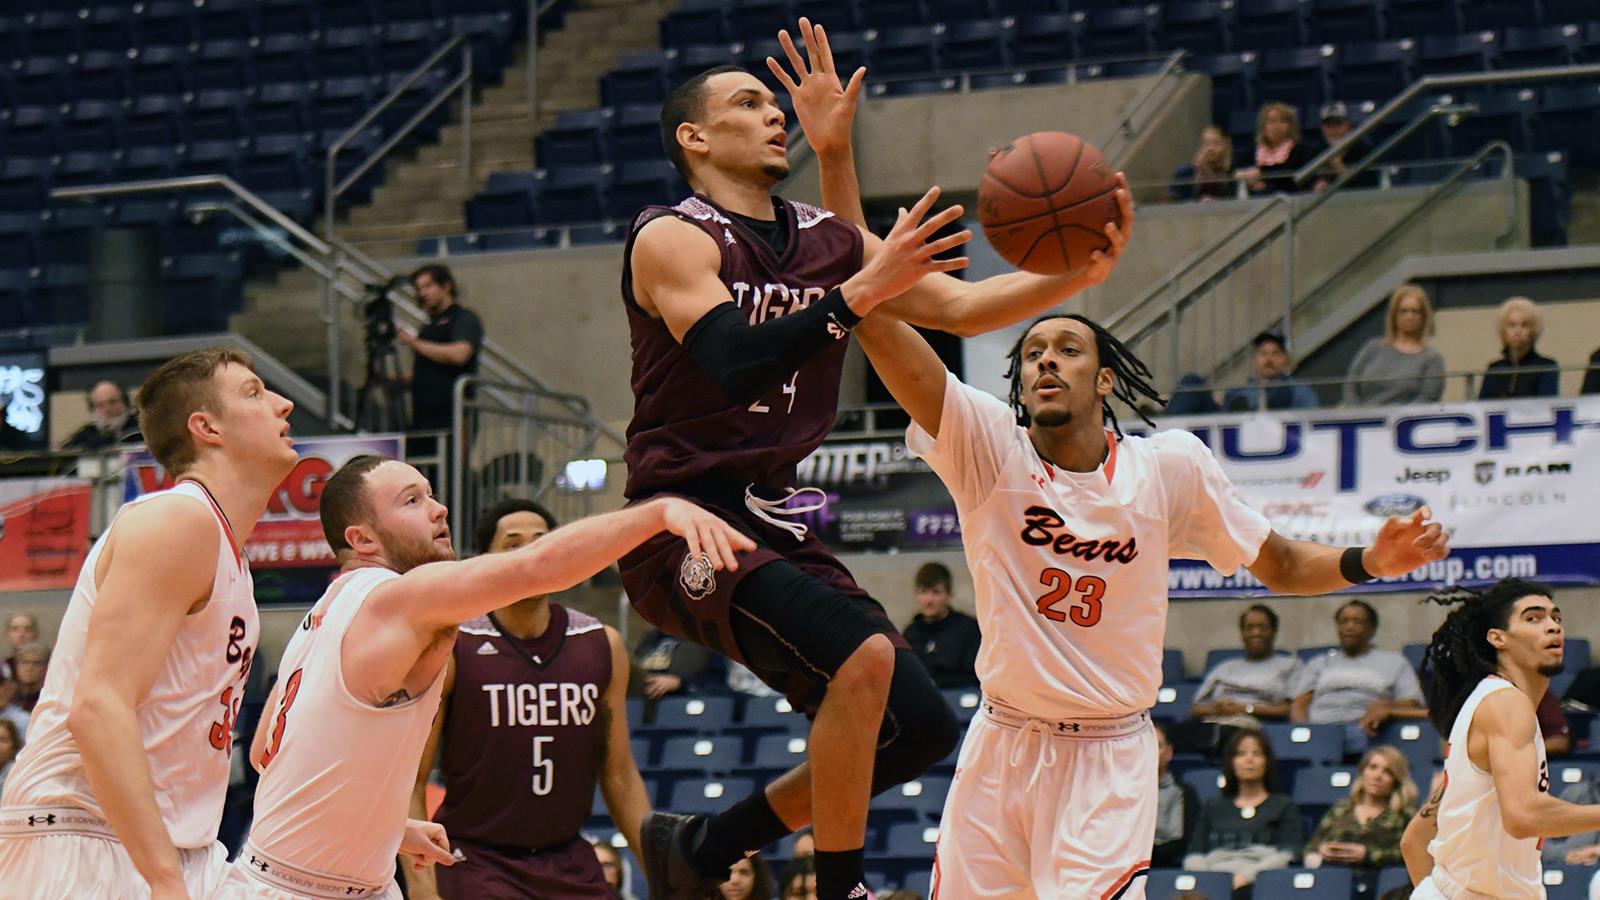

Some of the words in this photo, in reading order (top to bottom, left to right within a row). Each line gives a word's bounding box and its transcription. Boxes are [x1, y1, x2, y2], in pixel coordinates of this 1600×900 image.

[1396, 468, 1450, 484] Jeep
[1505, 463, 1571, 477] RAM
[1021, 505, 1138, 564] Bears
[1036, 567, 1106, 627] 23
[482, 683, 598, 727] TIGERS
[532, 736, 554, 795] 5
